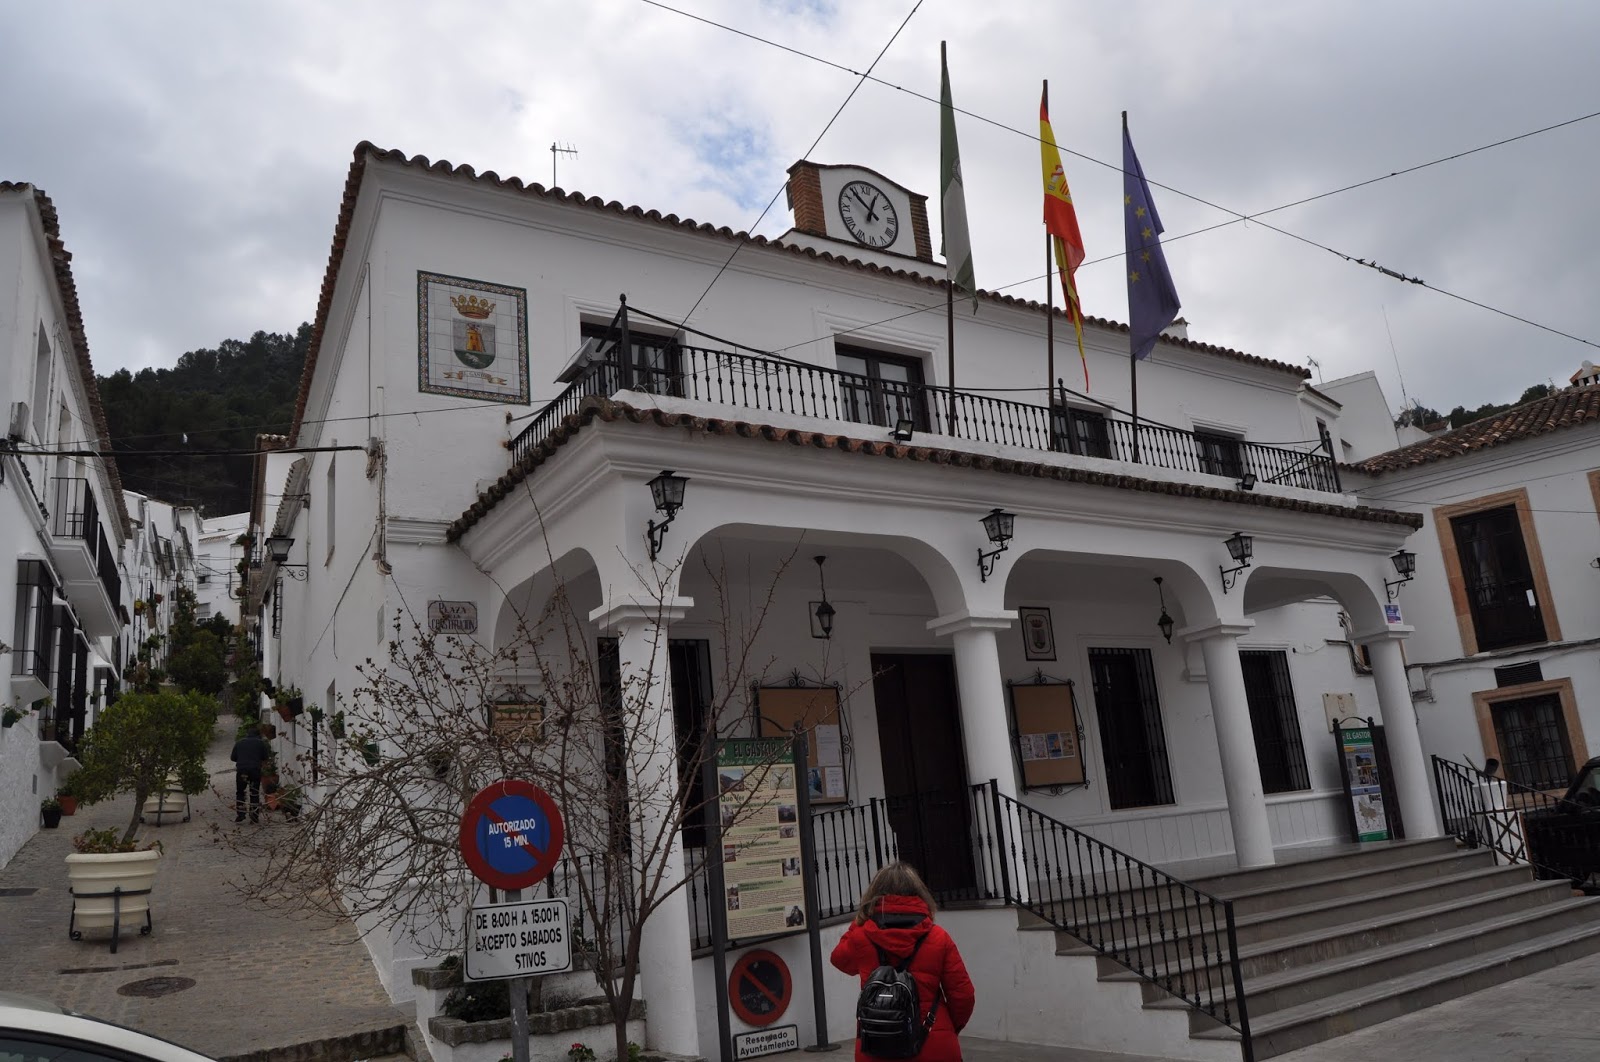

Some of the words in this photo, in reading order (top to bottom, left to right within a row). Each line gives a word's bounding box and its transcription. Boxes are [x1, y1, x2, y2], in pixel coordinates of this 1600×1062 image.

[733, 743, 743, 758] EL
[488, 818, 535, 835] AUTORIZADO
[503, 836, 511, 848] 15
[476, 914, 487, 930] DE
[521, 910, 528, 925] A
[476, 932, 517, 951] EXCEPTO
[520, 927, 562, 947] SABADOS
[740, 1039, 795, 1056] Ayuntamiento
